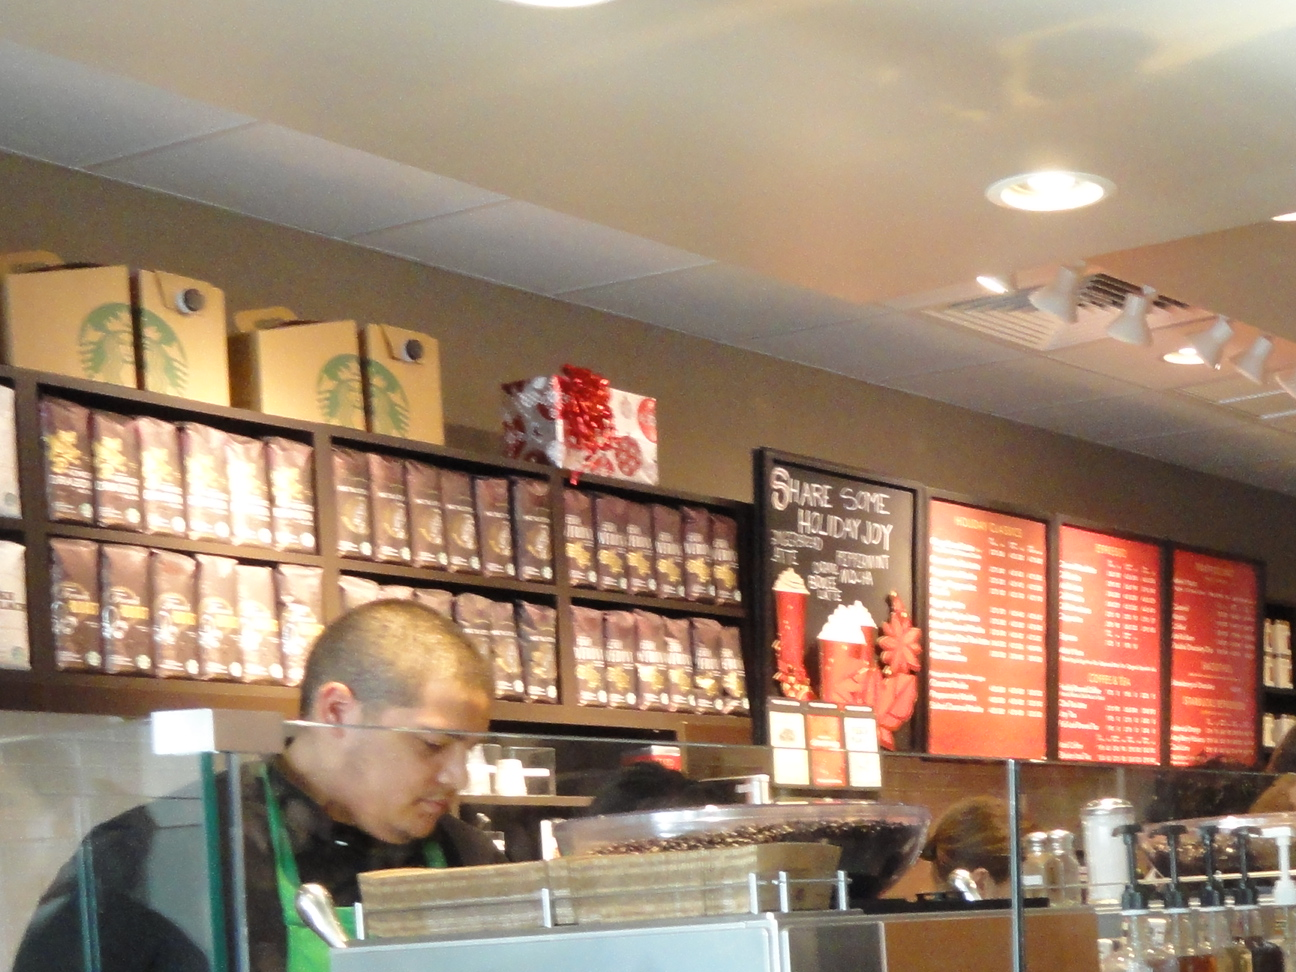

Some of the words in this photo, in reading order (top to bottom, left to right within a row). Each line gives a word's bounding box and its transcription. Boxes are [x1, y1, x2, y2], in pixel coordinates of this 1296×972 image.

[769, 467, 833, 511] SHARE
[839, 487, 891, 515] SOME
[797, 508, 861, 540] HOLIDAY
[861, 520, 894, 551] JOY
